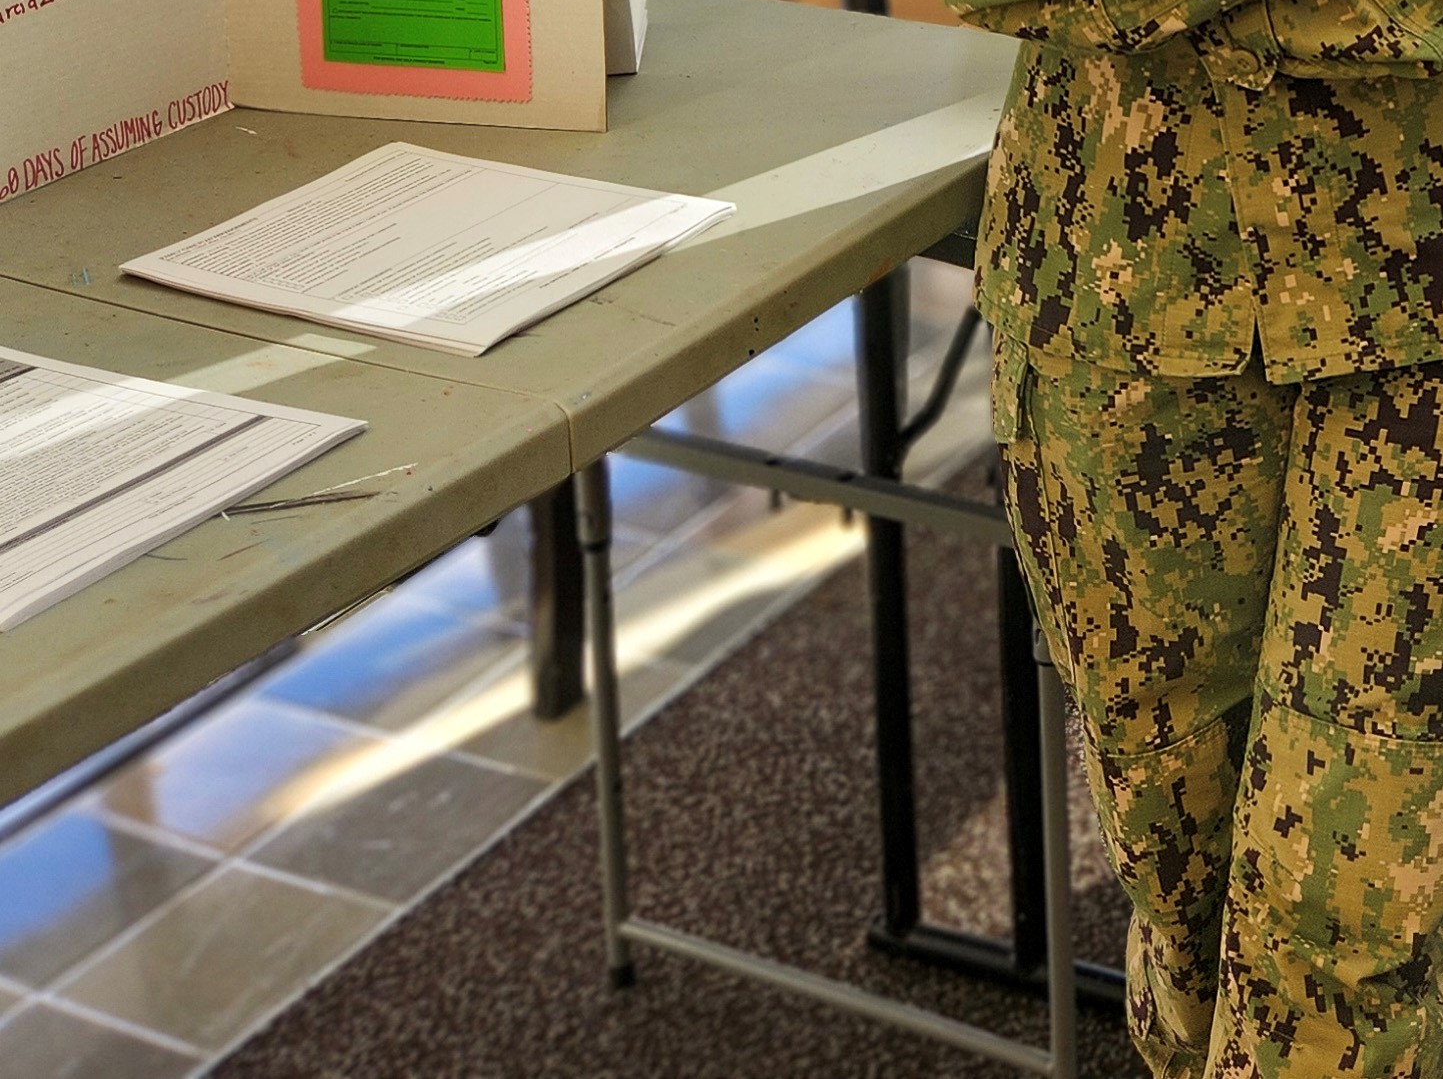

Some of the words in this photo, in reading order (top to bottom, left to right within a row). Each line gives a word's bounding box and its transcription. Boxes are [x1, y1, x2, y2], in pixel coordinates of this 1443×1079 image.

[23, 147, 65, 192] DAYS
[70, 135, 88, 171] OF
[92, 110, 163, 162] ASSUMING
[167, 80, 231, 130] CUSTODY
